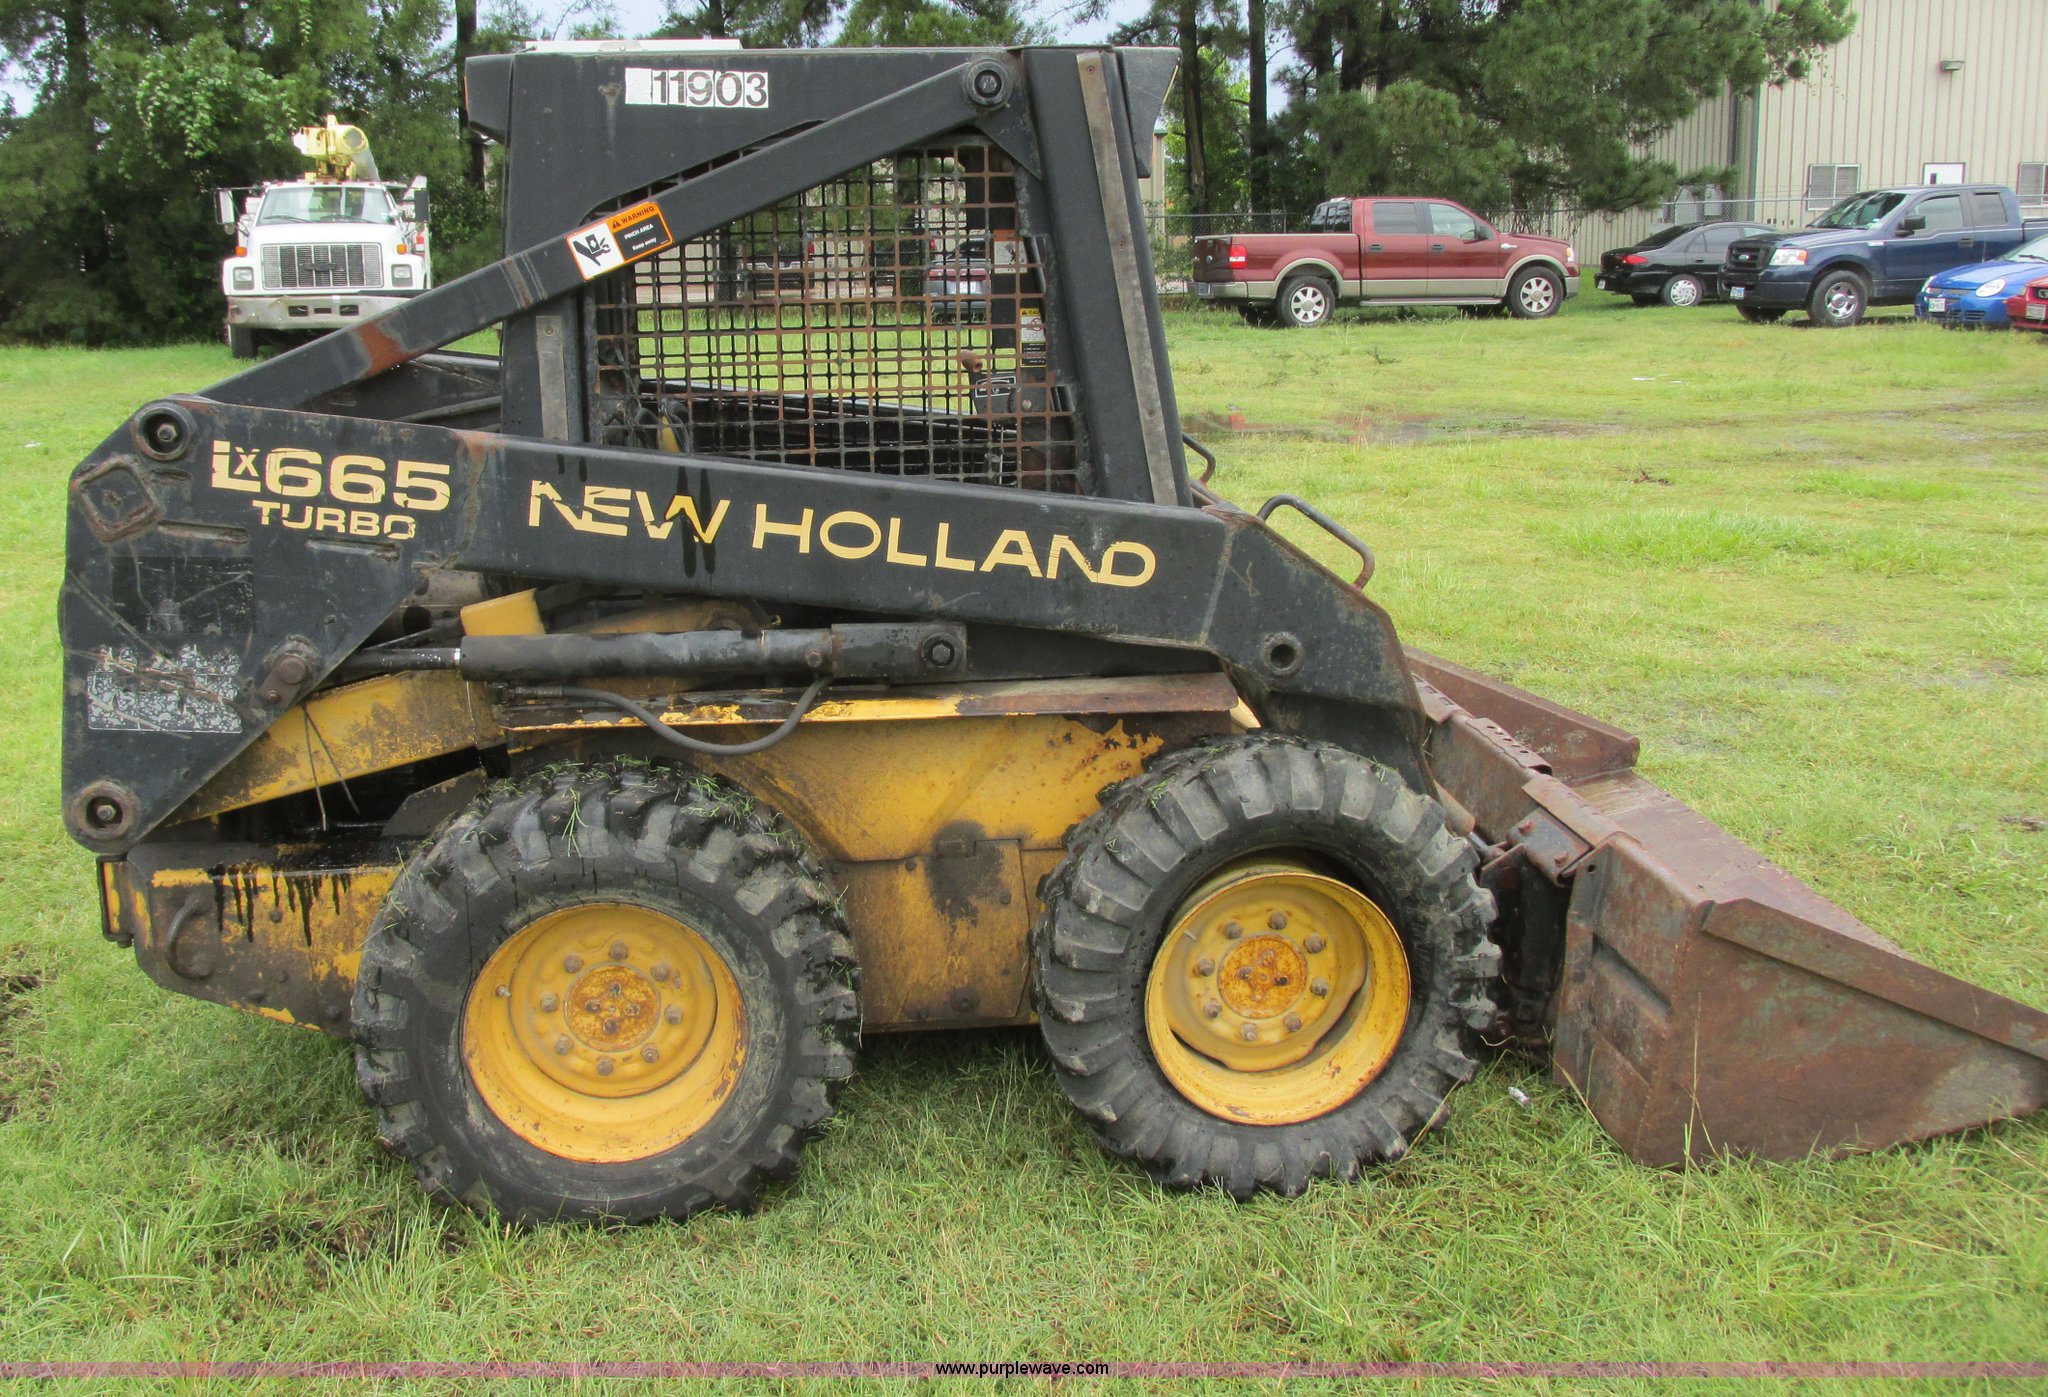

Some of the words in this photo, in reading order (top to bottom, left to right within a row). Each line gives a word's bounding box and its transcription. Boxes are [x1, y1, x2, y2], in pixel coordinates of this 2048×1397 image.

[654, 71, 767, 106] 11903
[620, 206, 655, 224] WARNING
[640, 223, 654, 233] AREA
[252, 499, 416, 540] TURBO
[528, 480, 730, 544] NEW
[752, 503, 1156, 587] HOLLAND
